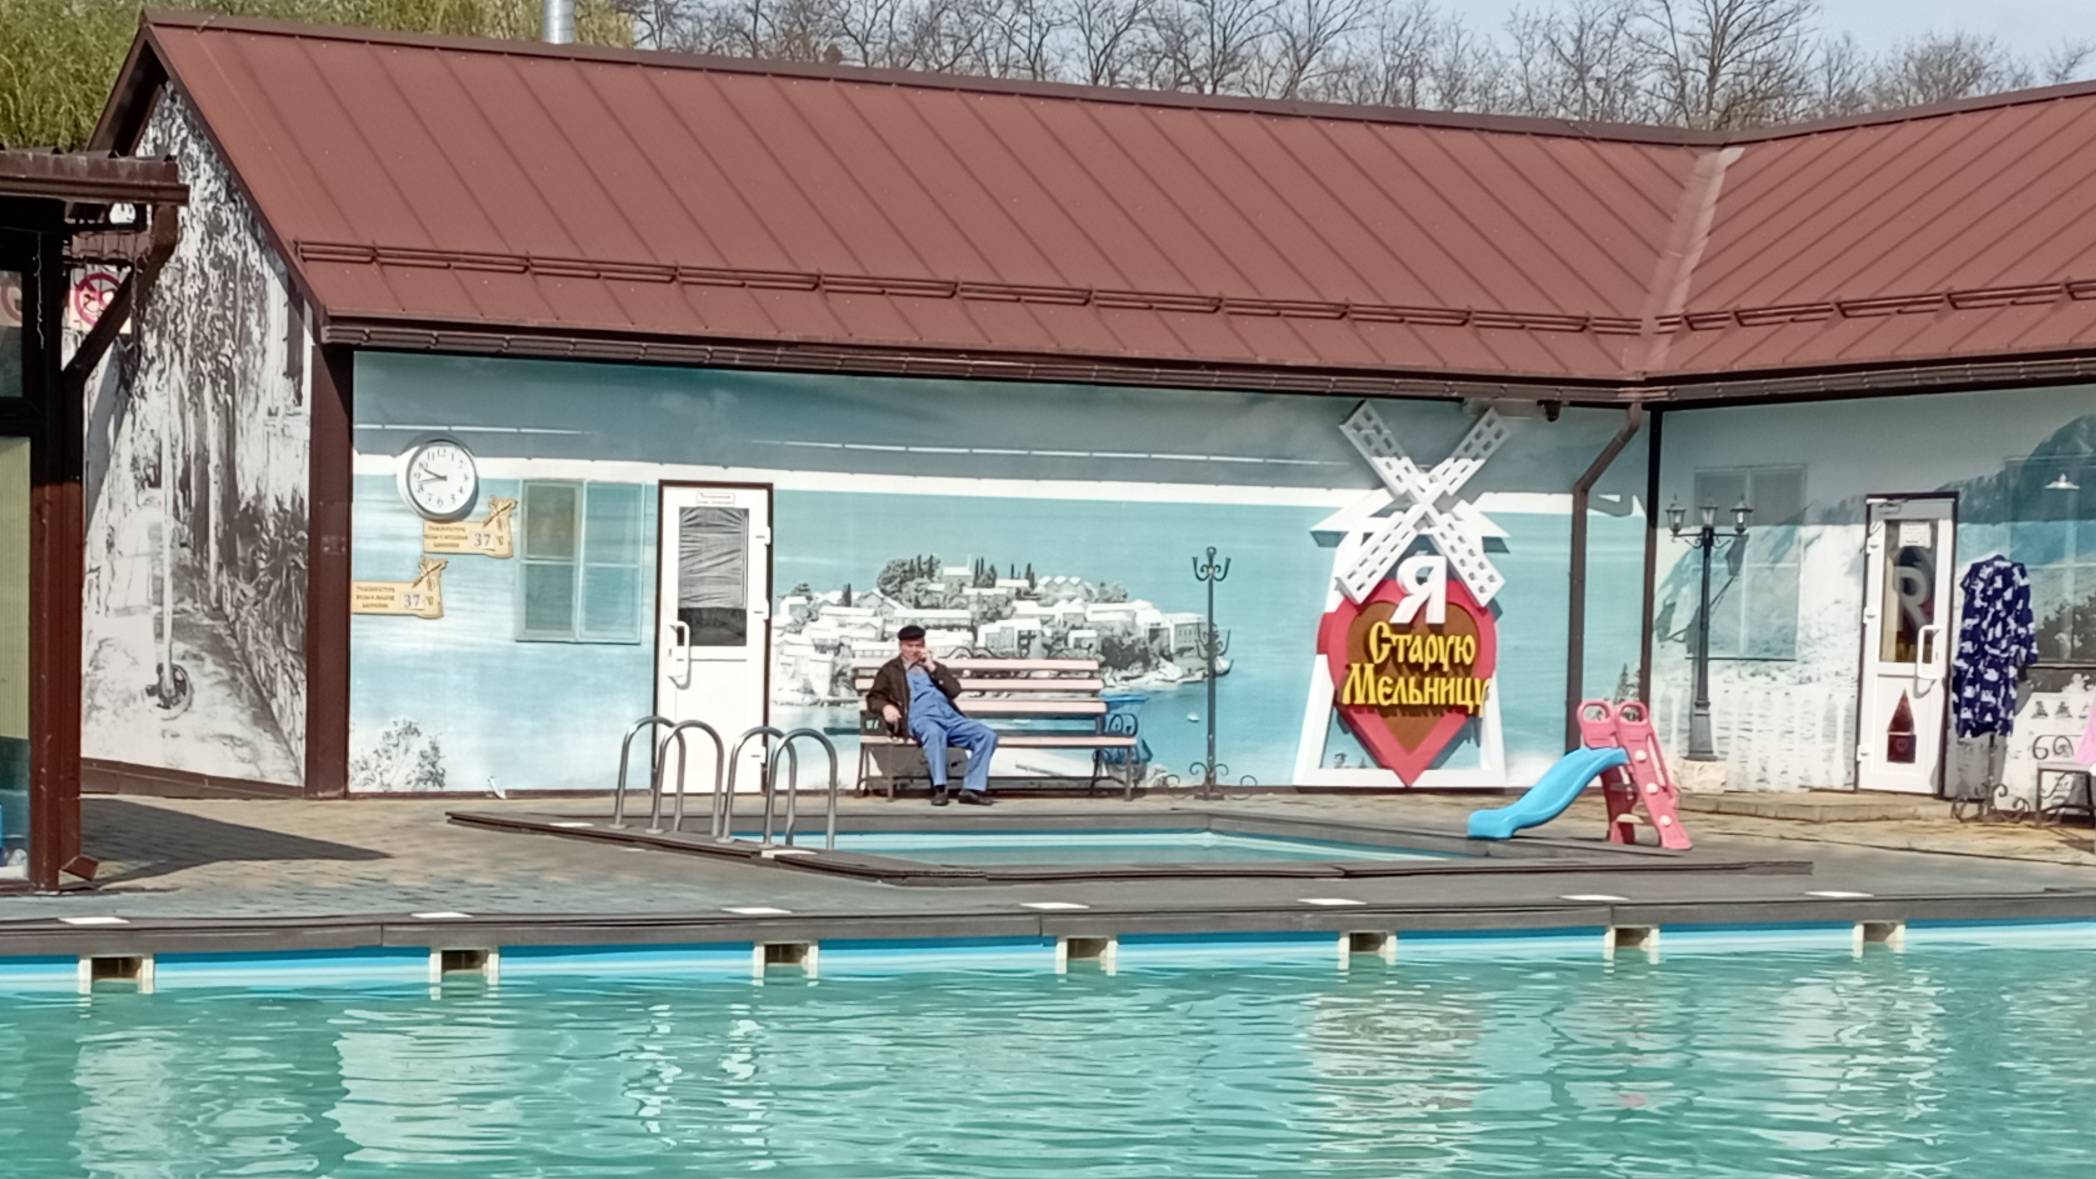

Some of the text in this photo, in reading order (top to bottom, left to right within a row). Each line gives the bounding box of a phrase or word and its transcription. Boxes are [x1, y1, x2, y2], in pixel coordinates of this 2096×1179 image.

[474, 533, 491, 546] 37
[403, 594, 420, 608] 37
[1389, 555, 1448, 624] Я
[1369, 621, 1476, 672] Старую
[1342, 662, 1492, 718] Мельницу
